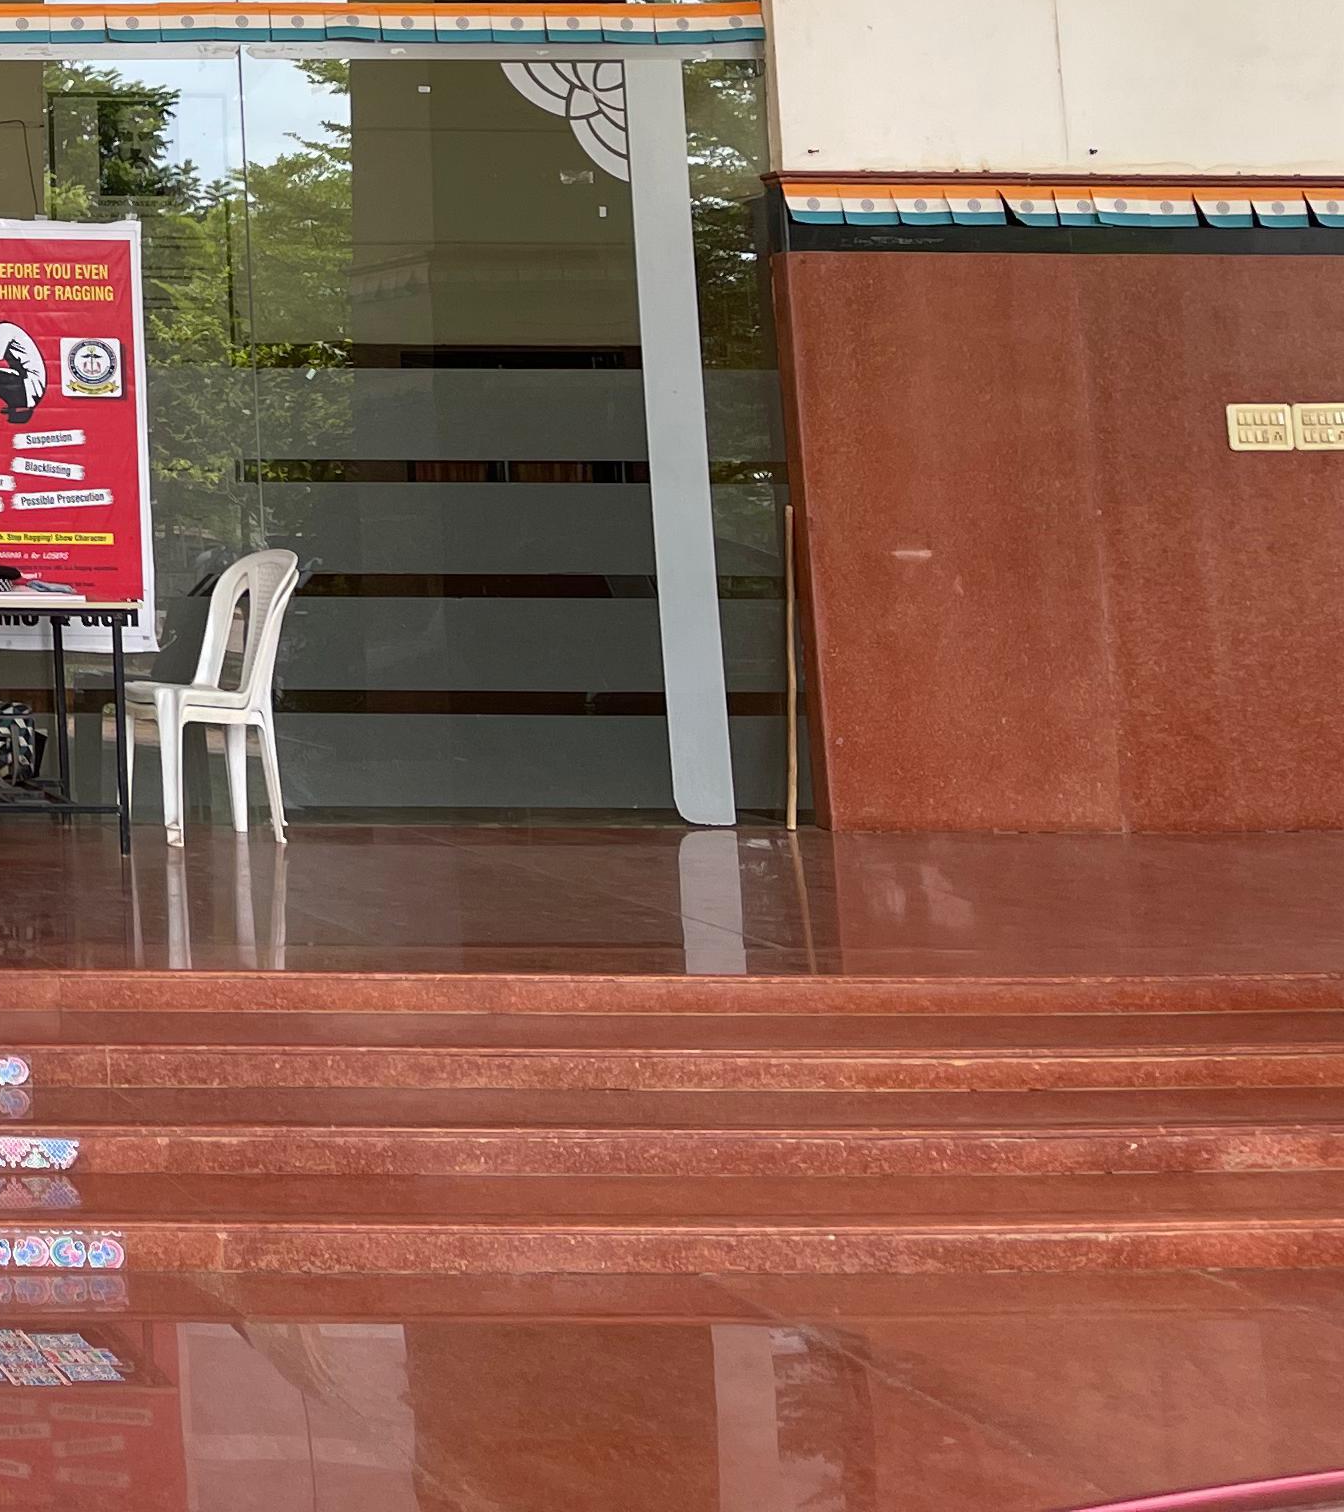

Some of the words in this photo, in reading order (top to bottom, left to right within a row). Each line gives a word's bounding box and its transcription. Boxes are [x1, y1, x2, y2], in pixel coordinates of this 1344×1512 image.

[44, 263, 71, 280] YOU
[75, 264, 109, 280] EVEN
[35, 285, 51, 301] OF
[55, 286, 114, 302] RAGGING
[26, 432, 73, 445] Suspension
[25, 461, 72, 477] Blacklisting
[21, 494, 55, 506] Possible
[57, 492, 105, 504] Prosecution
